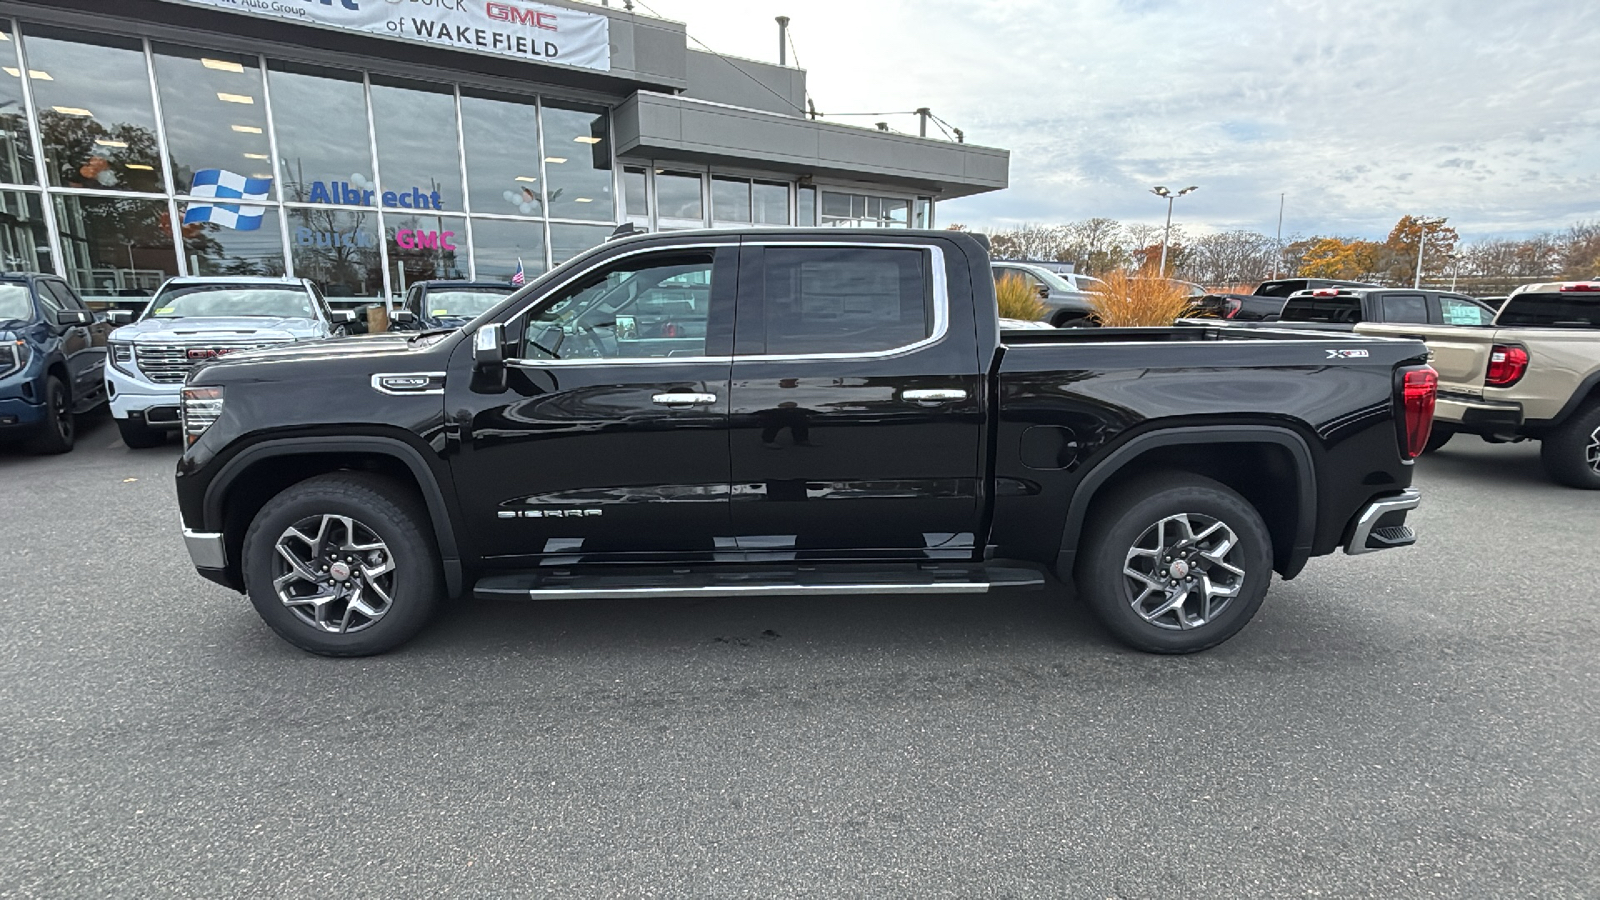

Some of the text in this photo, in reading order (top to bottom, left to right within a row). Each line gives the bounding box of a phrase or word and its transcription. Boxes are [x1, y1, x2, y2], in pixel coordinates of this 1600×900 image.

[271, 2, 306, 17] Group
[486, 2, 558, 32] GMC
[386, 17, 559, 58] of WAKEFIELD
[309, 181, 442, 211] Albrecht
[396, 229, 456, 250] GMC
